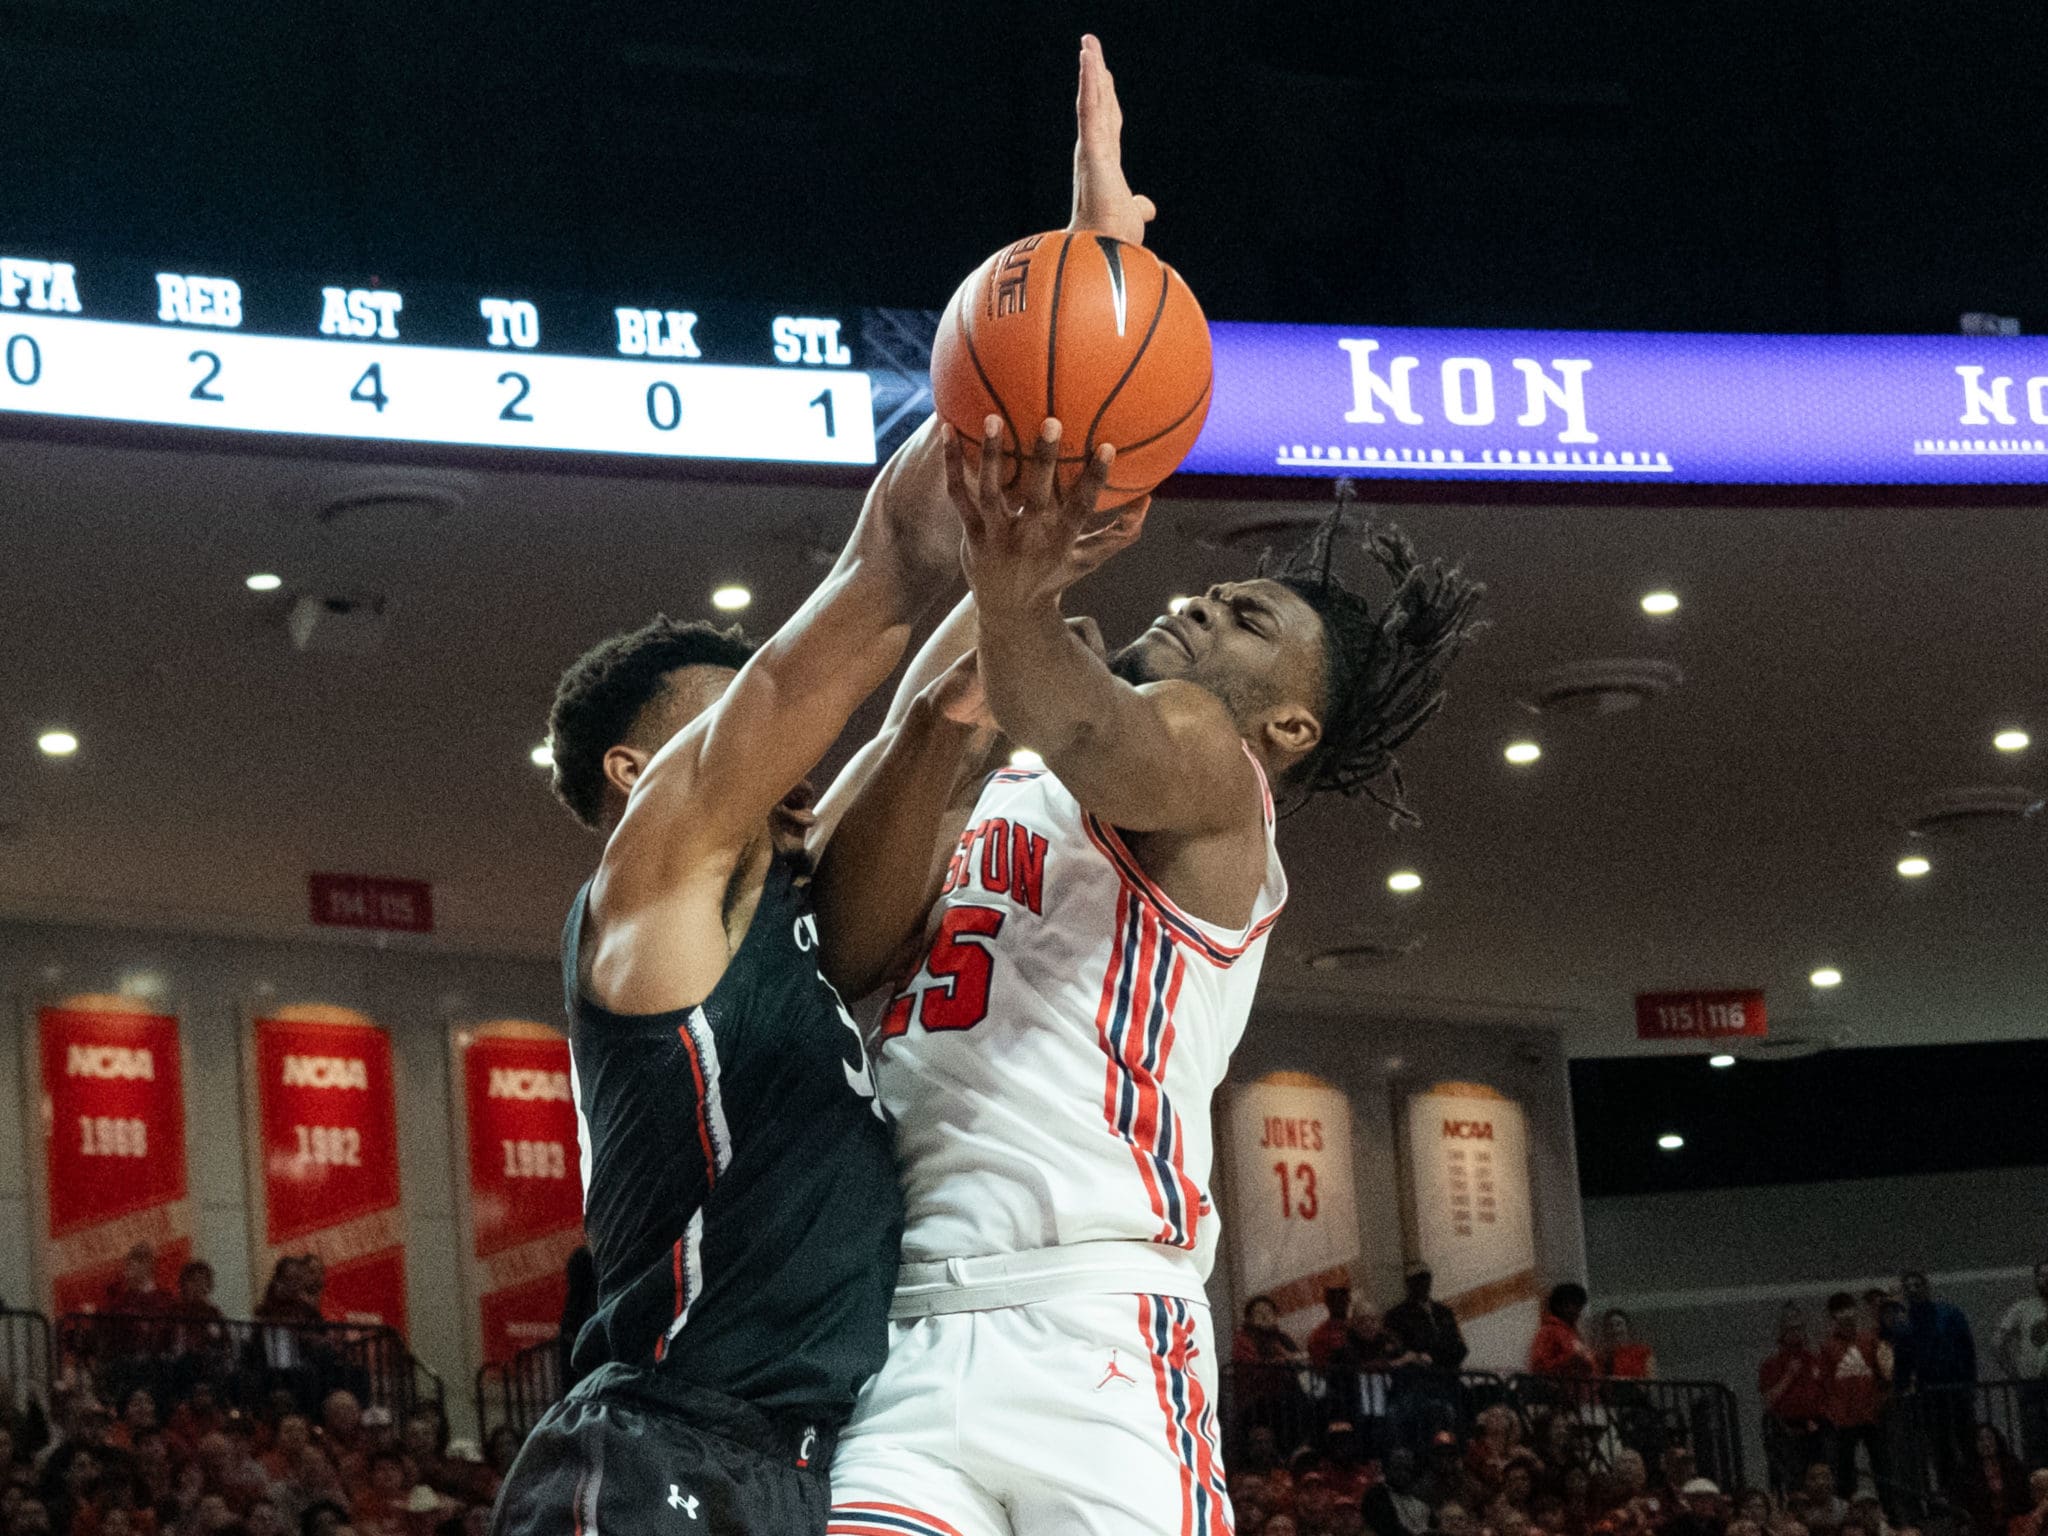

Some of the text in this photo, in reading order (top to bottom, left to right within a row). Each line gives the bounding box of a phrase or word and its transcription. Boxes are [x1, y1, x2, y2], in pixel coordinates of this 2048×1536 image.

[0, 257, 851, 364] FTA REB AST TO BLK STL
[6, 334, 836, 438] 0 2 4 2 0 1
[1955, 365, 2048, 425] NO
[942, 817, 1049, 917] STON
[1659, 1002, 1746, 1030] 115 116
[66, 1044, 155, 1082] NCAA
[282, 1054, 369, 1091] NCAA
[488, 1068, 572, 1102] NCAA
[1260, 1116, 1324, 1152] JONES
[1443, 1120, 1494, 1141] NCAA
[1273, 1161, 1318, 1220] 13
